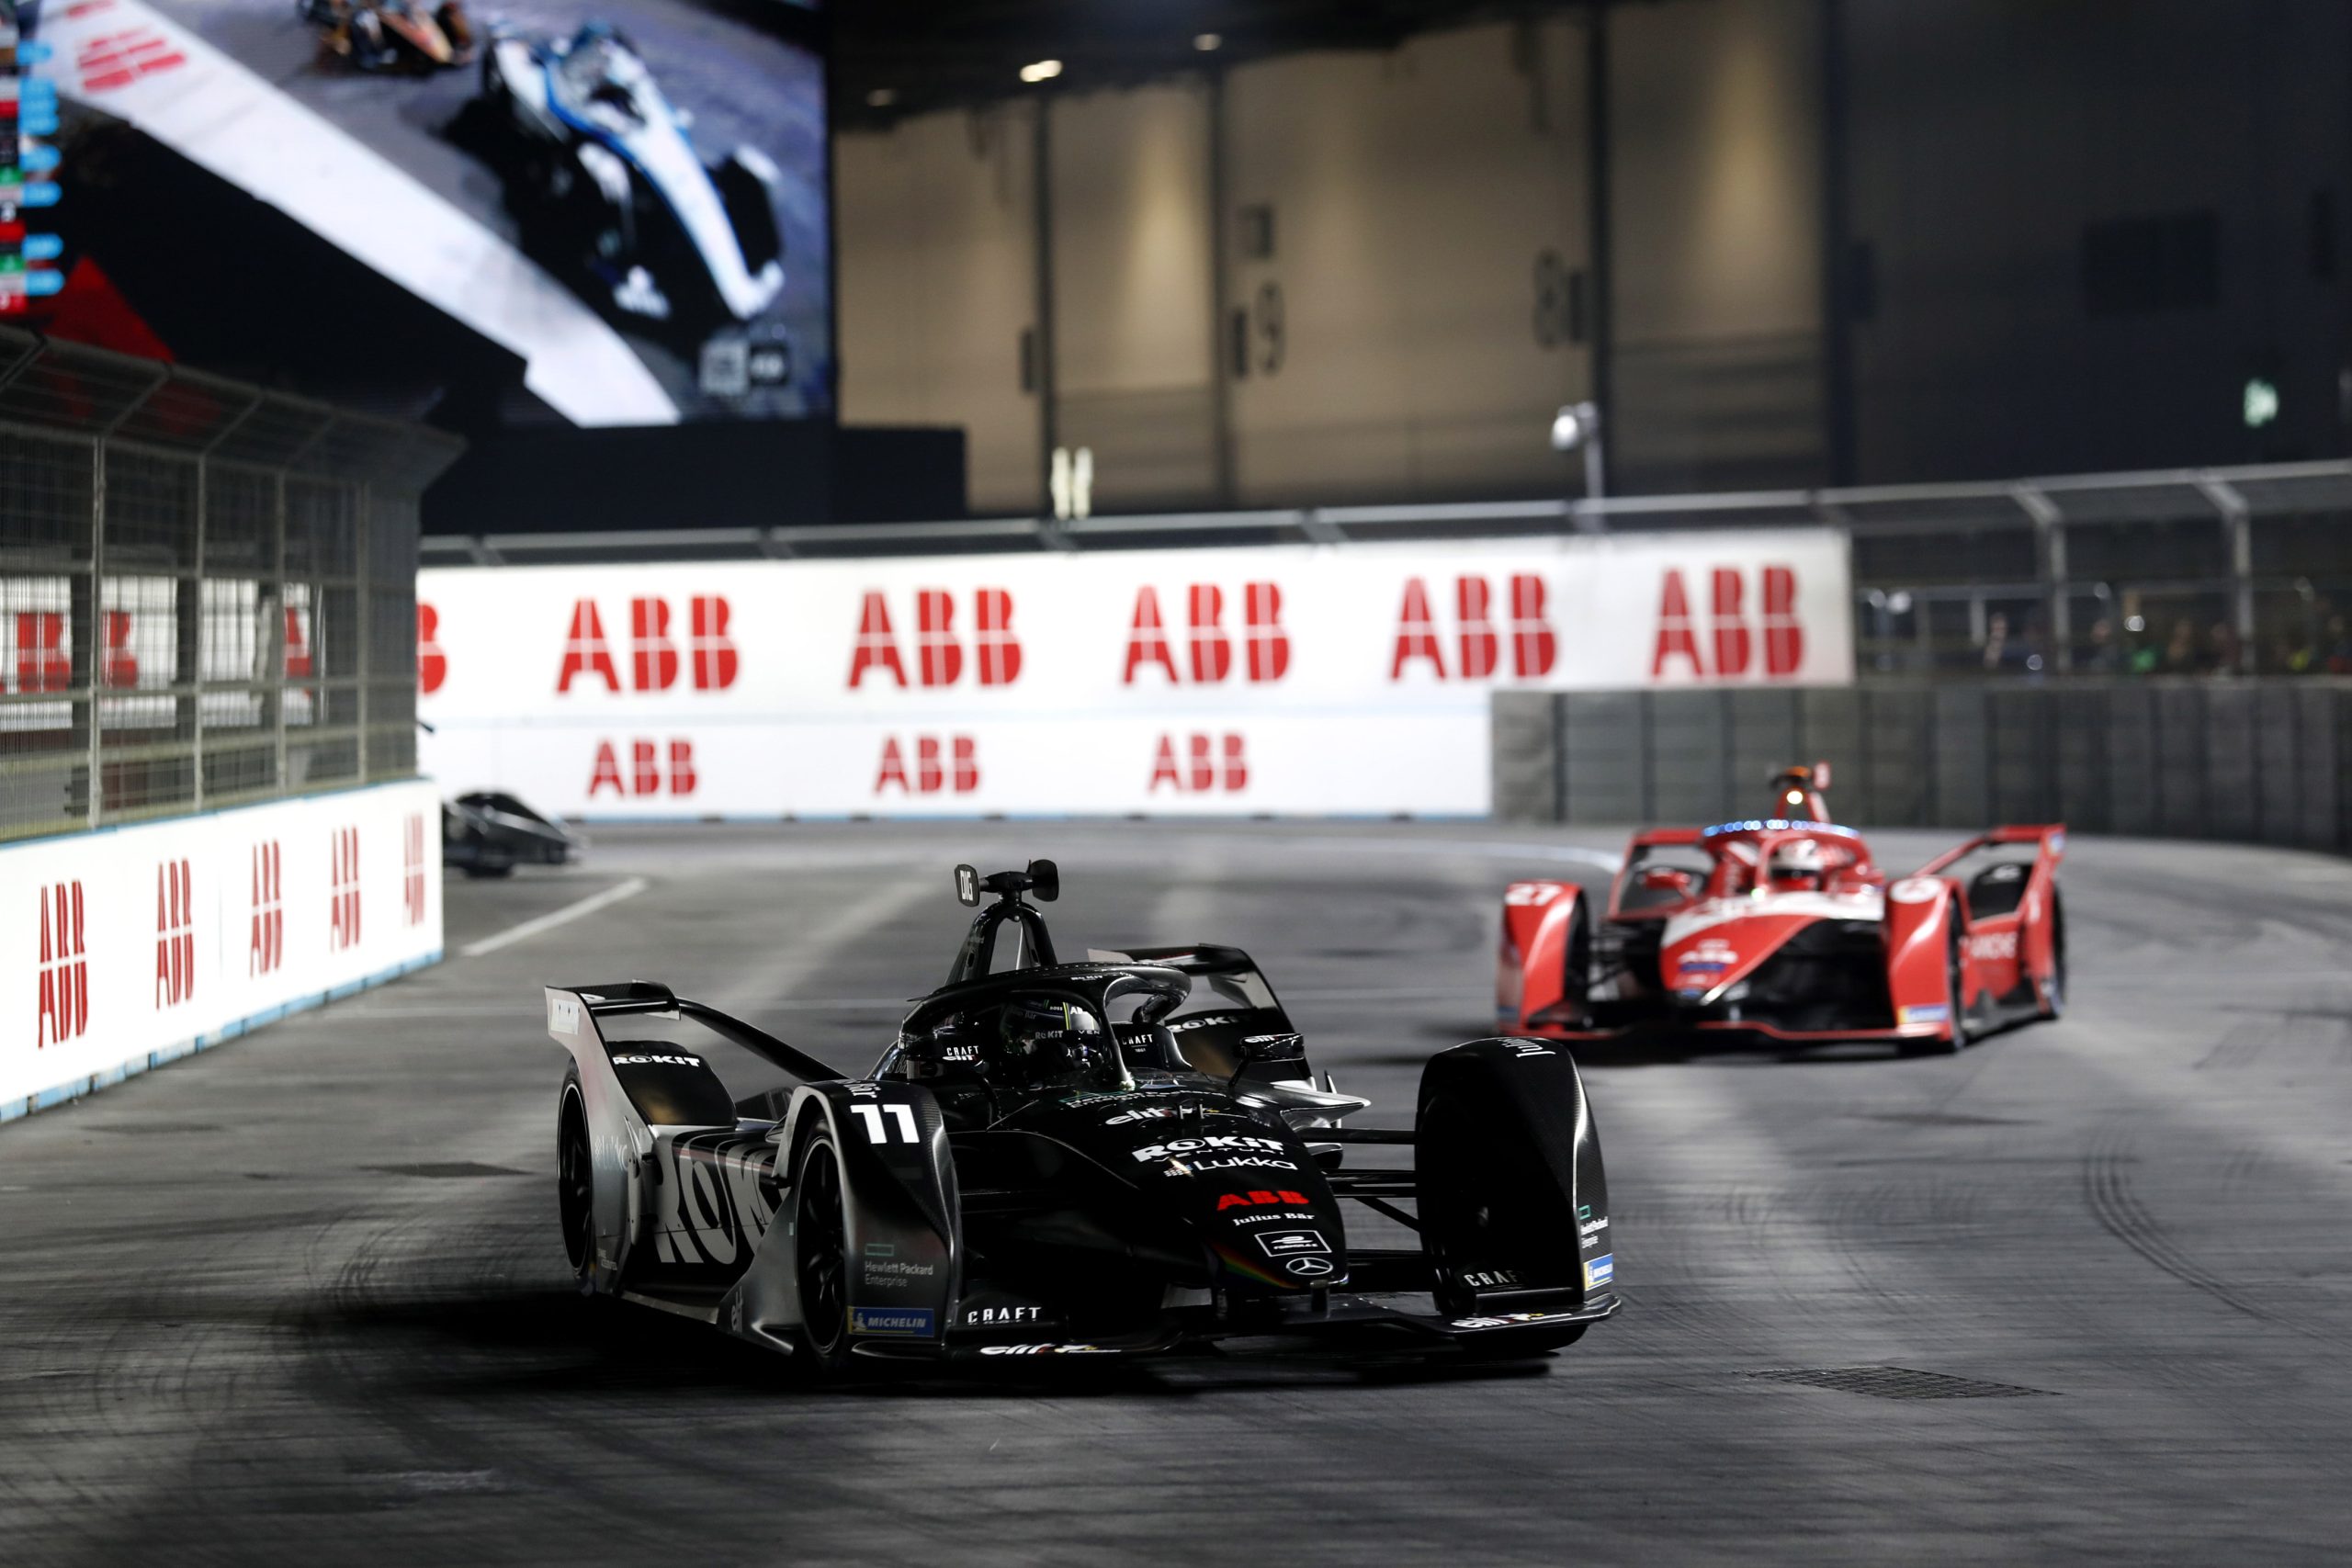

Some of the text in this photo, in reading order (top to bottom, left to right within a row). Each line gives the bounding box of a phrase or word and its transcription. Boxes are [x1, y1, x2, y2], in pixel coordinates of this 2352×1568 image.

[555, 593, 741, 695] ABB
[847, 586, 1025, 691] ABB
[1122, 581, 1293, 687] ABB
[1390, 572, 1558, 682] ABB
[1648, 565, 1807, 682] ABB
[588, 739, 698, 798] ABB
[876, 736, 981, 795] ABB
[1149, 733, 1250, 794] ABB
[250, 839, 283, 978] ABB
[330, 826, 361, 953] ABB
[1505, 883, 1563, 907] 27
[156, 857, 195, 1010] ABB
[38, 879, 88, 1050] ABB
[946, 1045, 979, 1056] CRAFT
[849, 1103, 921, 1145] 11
[1216, 1190, 1309, 1211] ABB
[1232, 1213, 1282, 1226] Julius
[865, 1260, 934, 1275] Hewlett Packard
[865, 1273, 909, 1288] Enterprise
[867, 1317, 927, 1328] MICHELIN
[967, 1306, 1042, 1323] CRAFT
